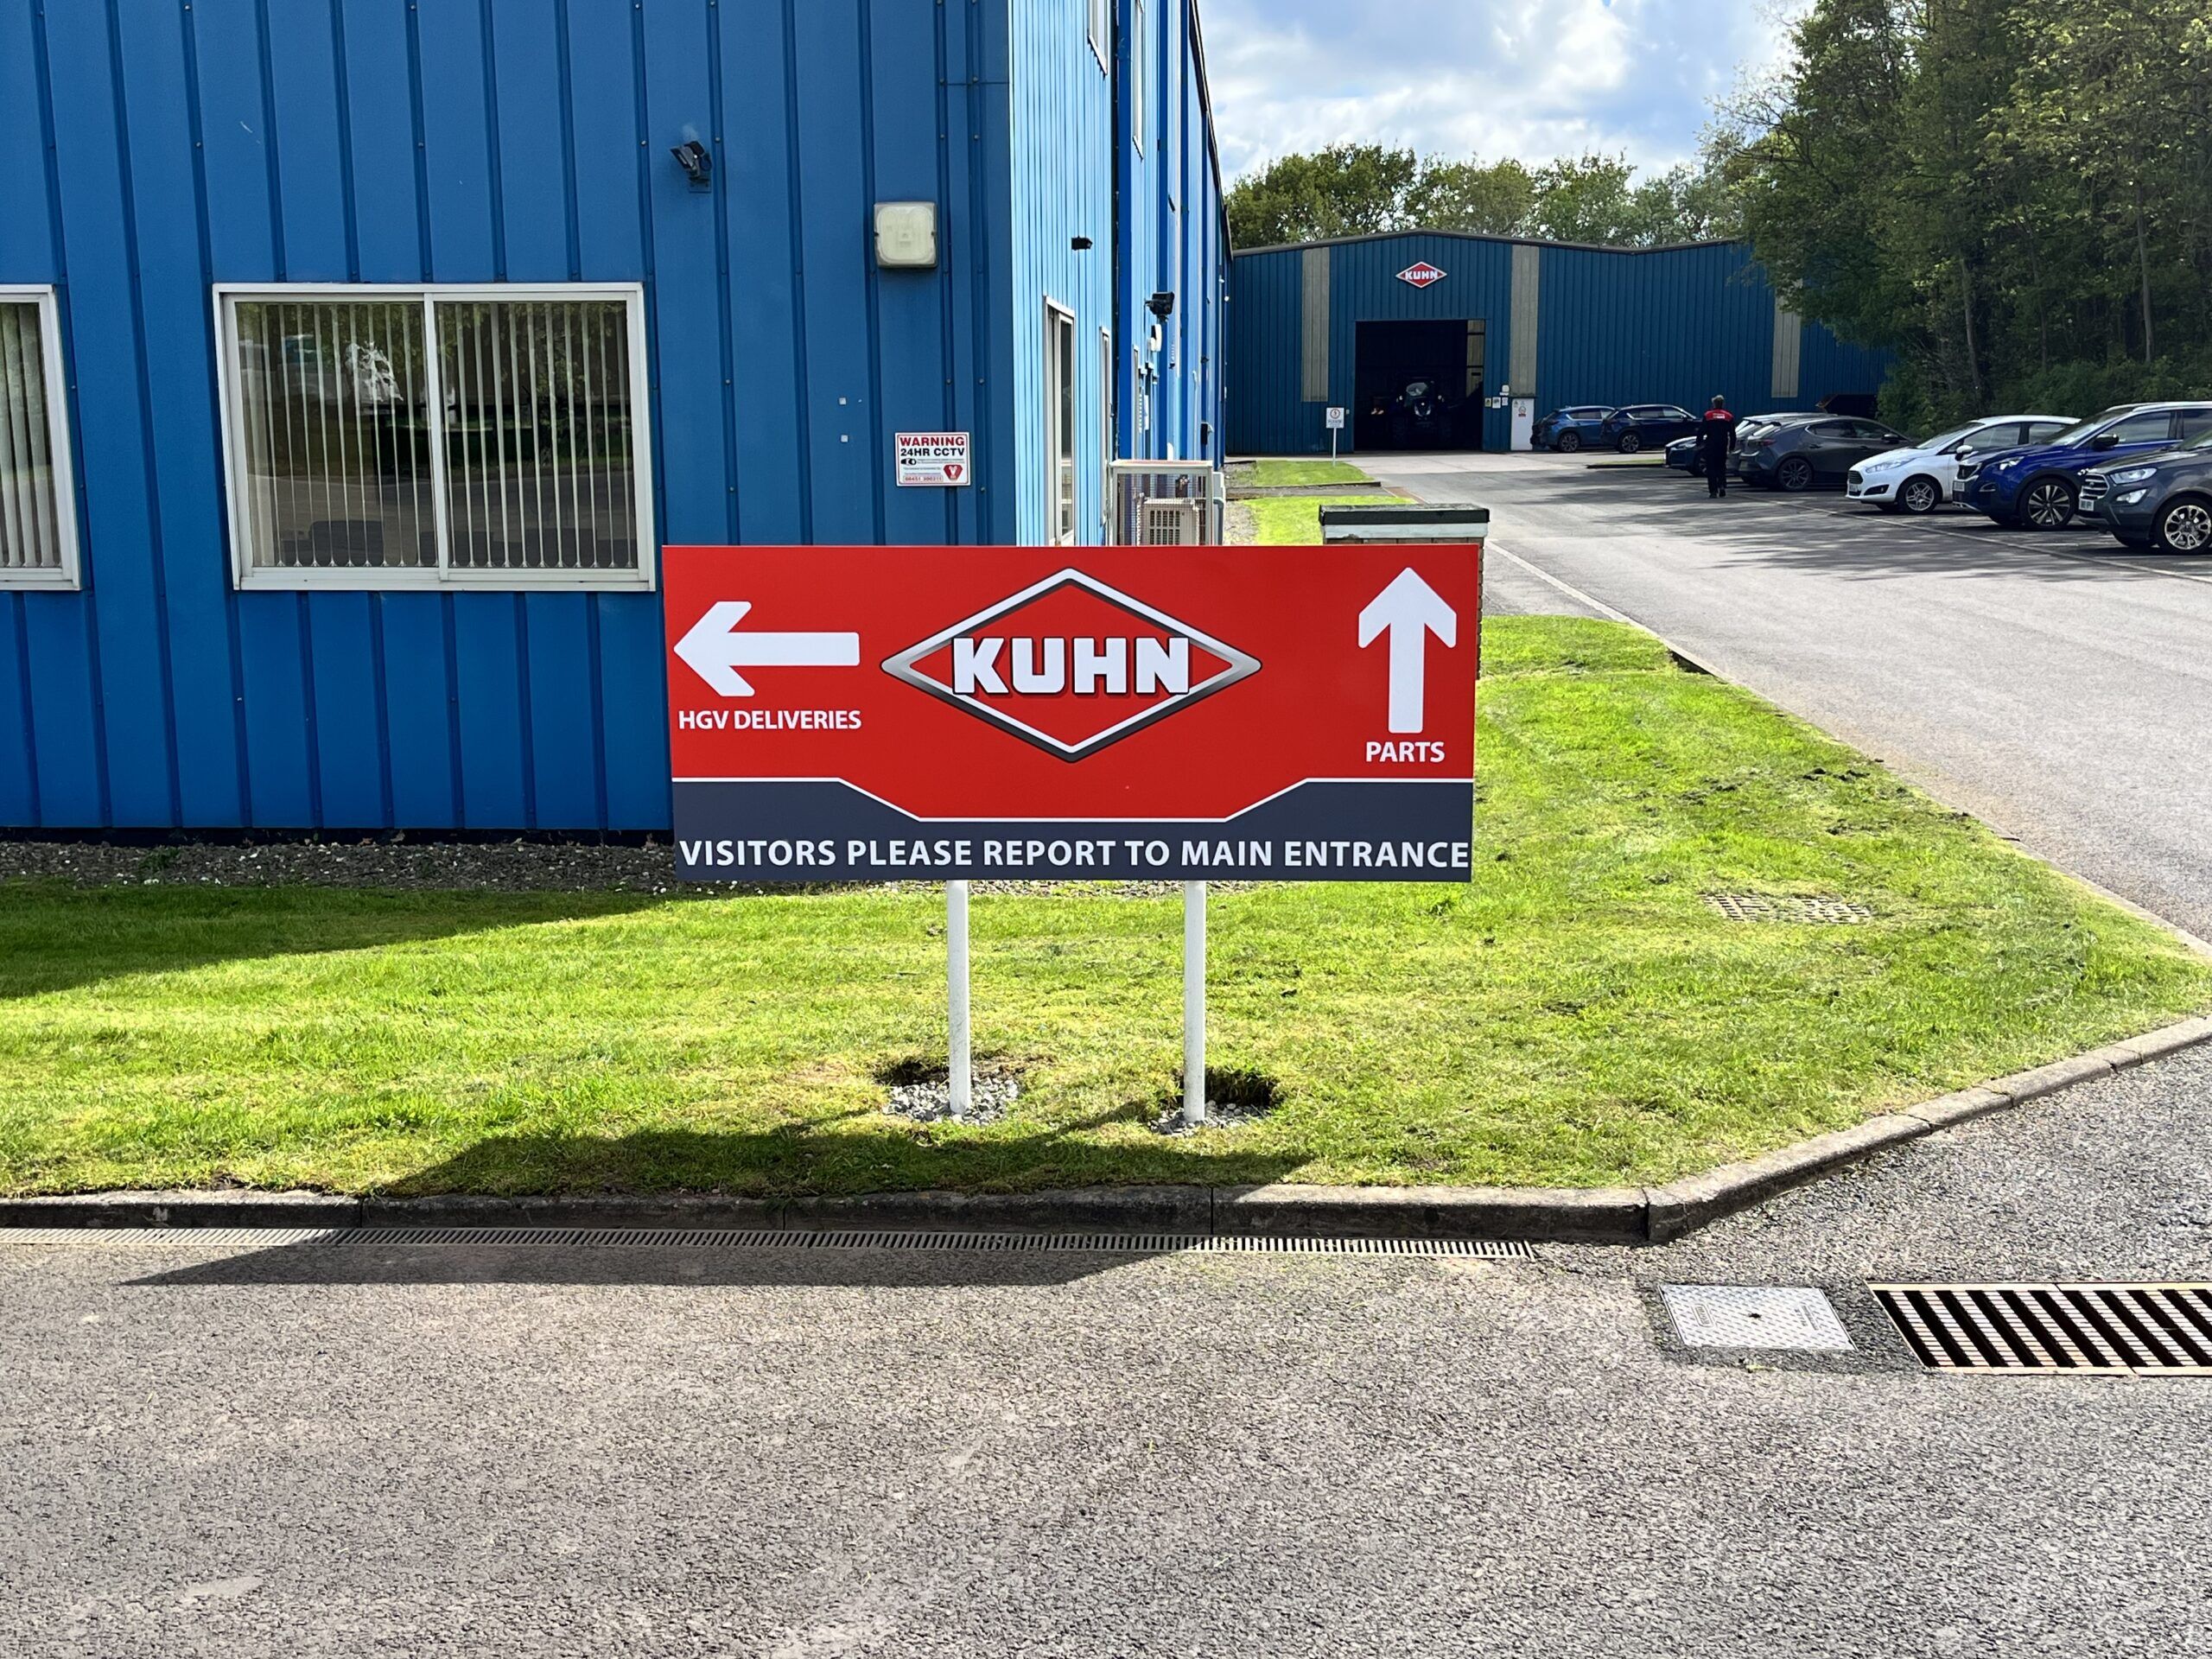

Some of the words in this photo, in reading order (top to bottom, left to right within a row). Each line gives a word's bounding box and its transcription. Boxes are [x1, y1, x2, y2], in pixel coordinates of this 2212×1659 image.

[1405, 270, 1439, 280] KUHN
[899, 436, 964, 446] WARNING
[900, 448, 930, 456] 24HR
[933, 448, 964, 456] CCTV
[952, 636, 1190, 695] KUHN
[678, 709, 729, 730] HGV
[734, 709, 862, 730] DELIVERIES
[1365, 741, 1446, 764] PARTS
[678, 839, 836, 868] VISITORS
[847, 839, 973, 868] PLEASE
[982, 839, 1116, 868] REPORT
[1124, 839, 1171, 868] TO
[1180, 839, 1273, 868] MAIN
[1284, 839, 1470, 868] ENTRANCE
